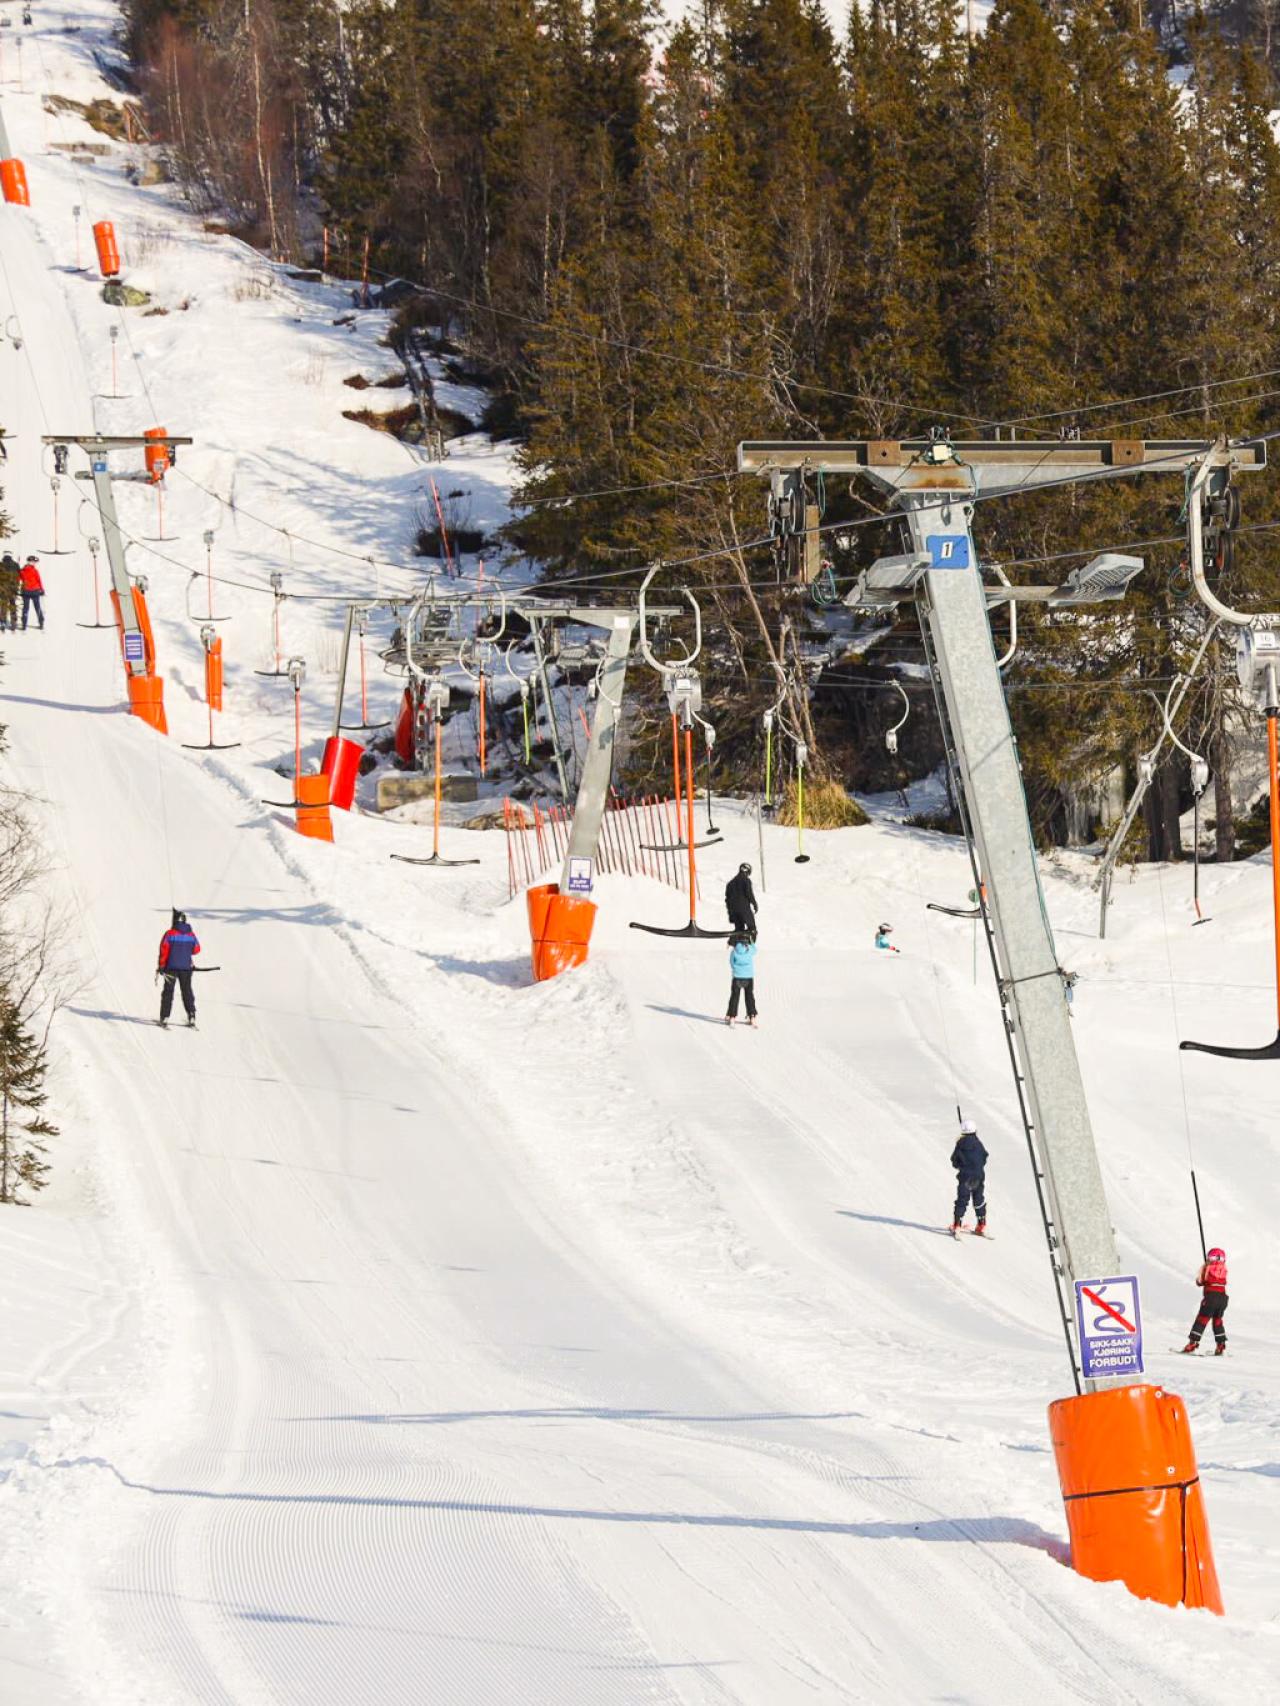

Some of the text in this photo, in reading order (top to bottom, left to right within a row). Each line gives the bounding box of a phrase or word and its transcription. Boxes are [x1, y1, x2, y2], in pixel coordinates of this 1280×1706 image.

[944, 543, 950, 557] 1
[1090, 1339, 1135, 1349] SIKK-SAKK
[1094, 1347, 1130, 1357] KJØRING
[1090, 1355, 1137, 1368] FORBUDT
